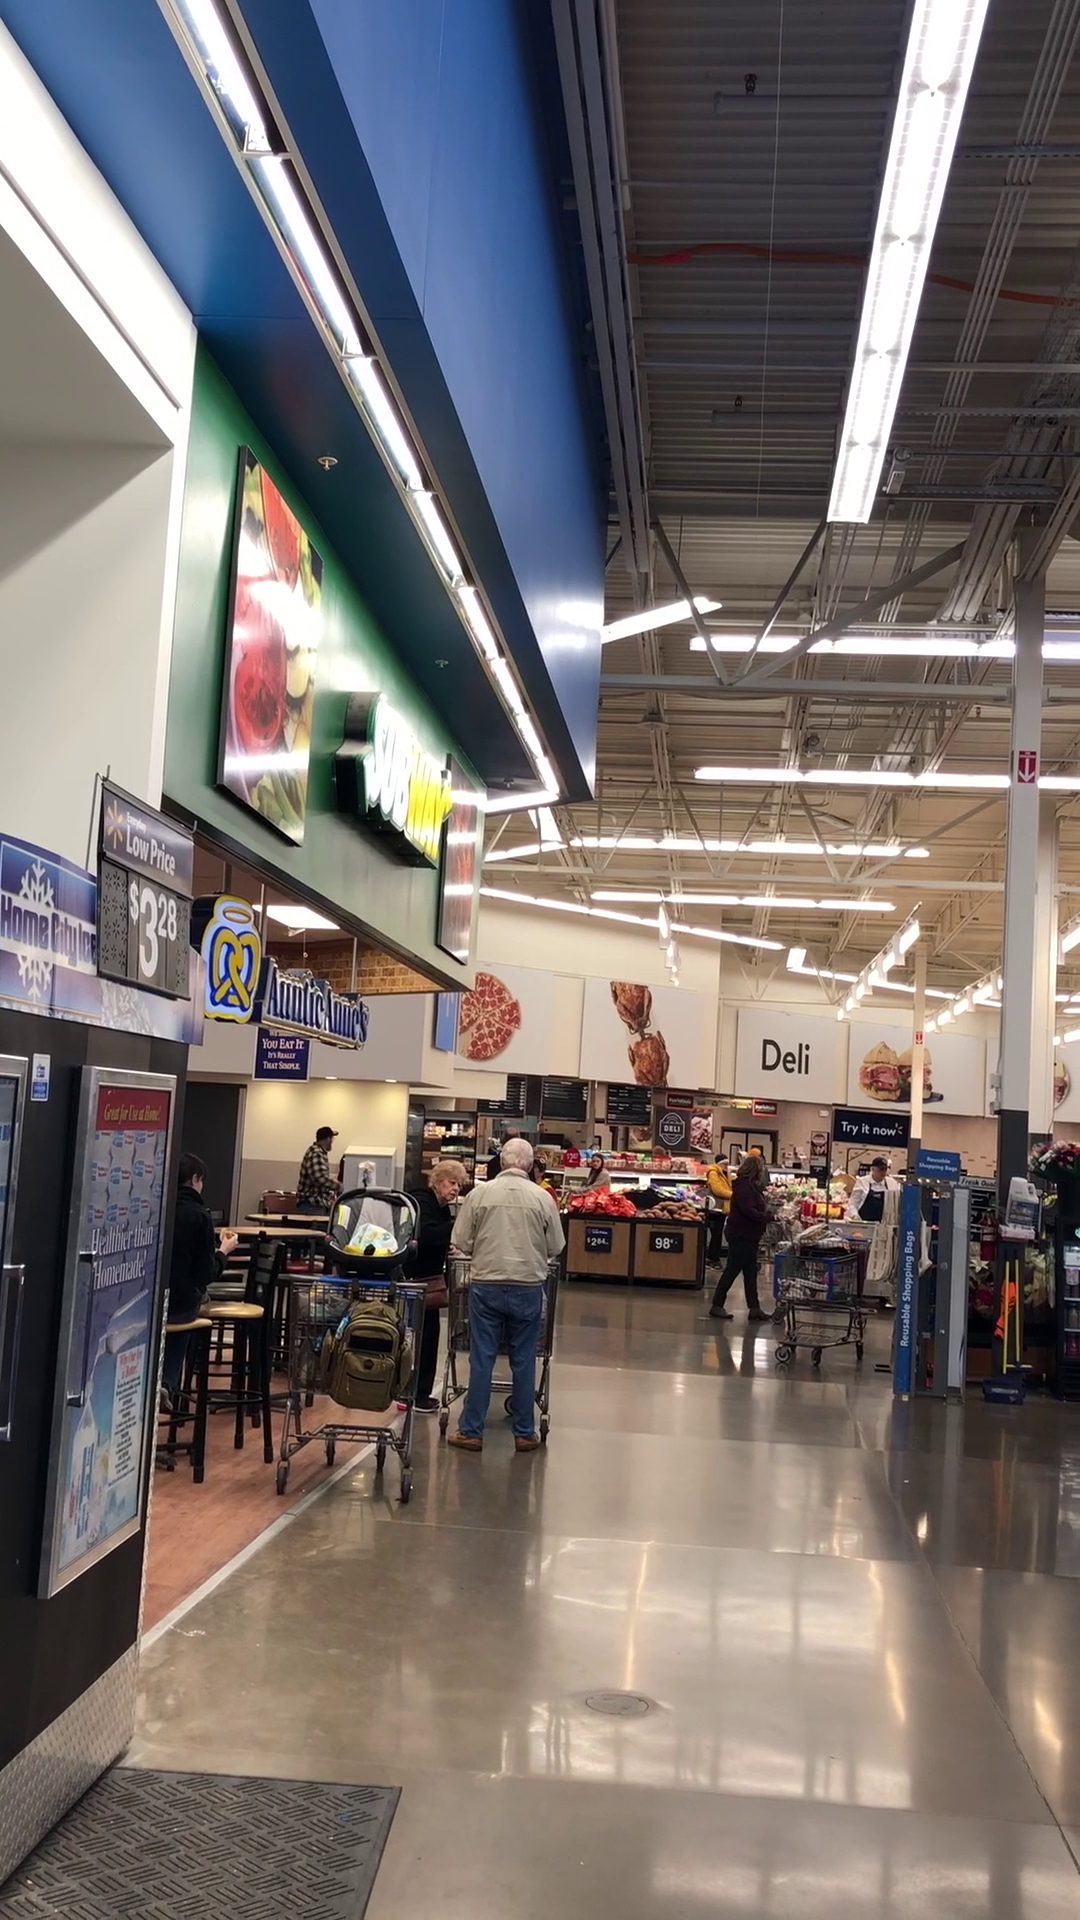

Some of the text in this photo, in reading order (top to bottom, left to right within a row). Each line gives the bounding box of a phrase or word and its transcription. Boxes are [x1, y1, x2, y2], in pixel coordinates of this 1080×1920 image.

[126, 811, 147, 834] Everyday
[126, 825, 176, 877] Low Price
[0, 893, 50, 950] Home
[51, 911, 78, 968] City
[761, 1038, 810, 1075] Deli
[663, 1125, 681, 1133] DELI
[841, 1120, 897, 1137] Try it now
[918, 1162, 944, 1172] Shopping
[944, 1165, 958, 1173] Bags
[926, 1156, 951, 1165] Reusable
[91, 1220, 154, 1257] Healthier than
[93, 1249, 147, 1290] Homemade!
[900, 1230, 915, 1347] Reusable Shopping Bags
